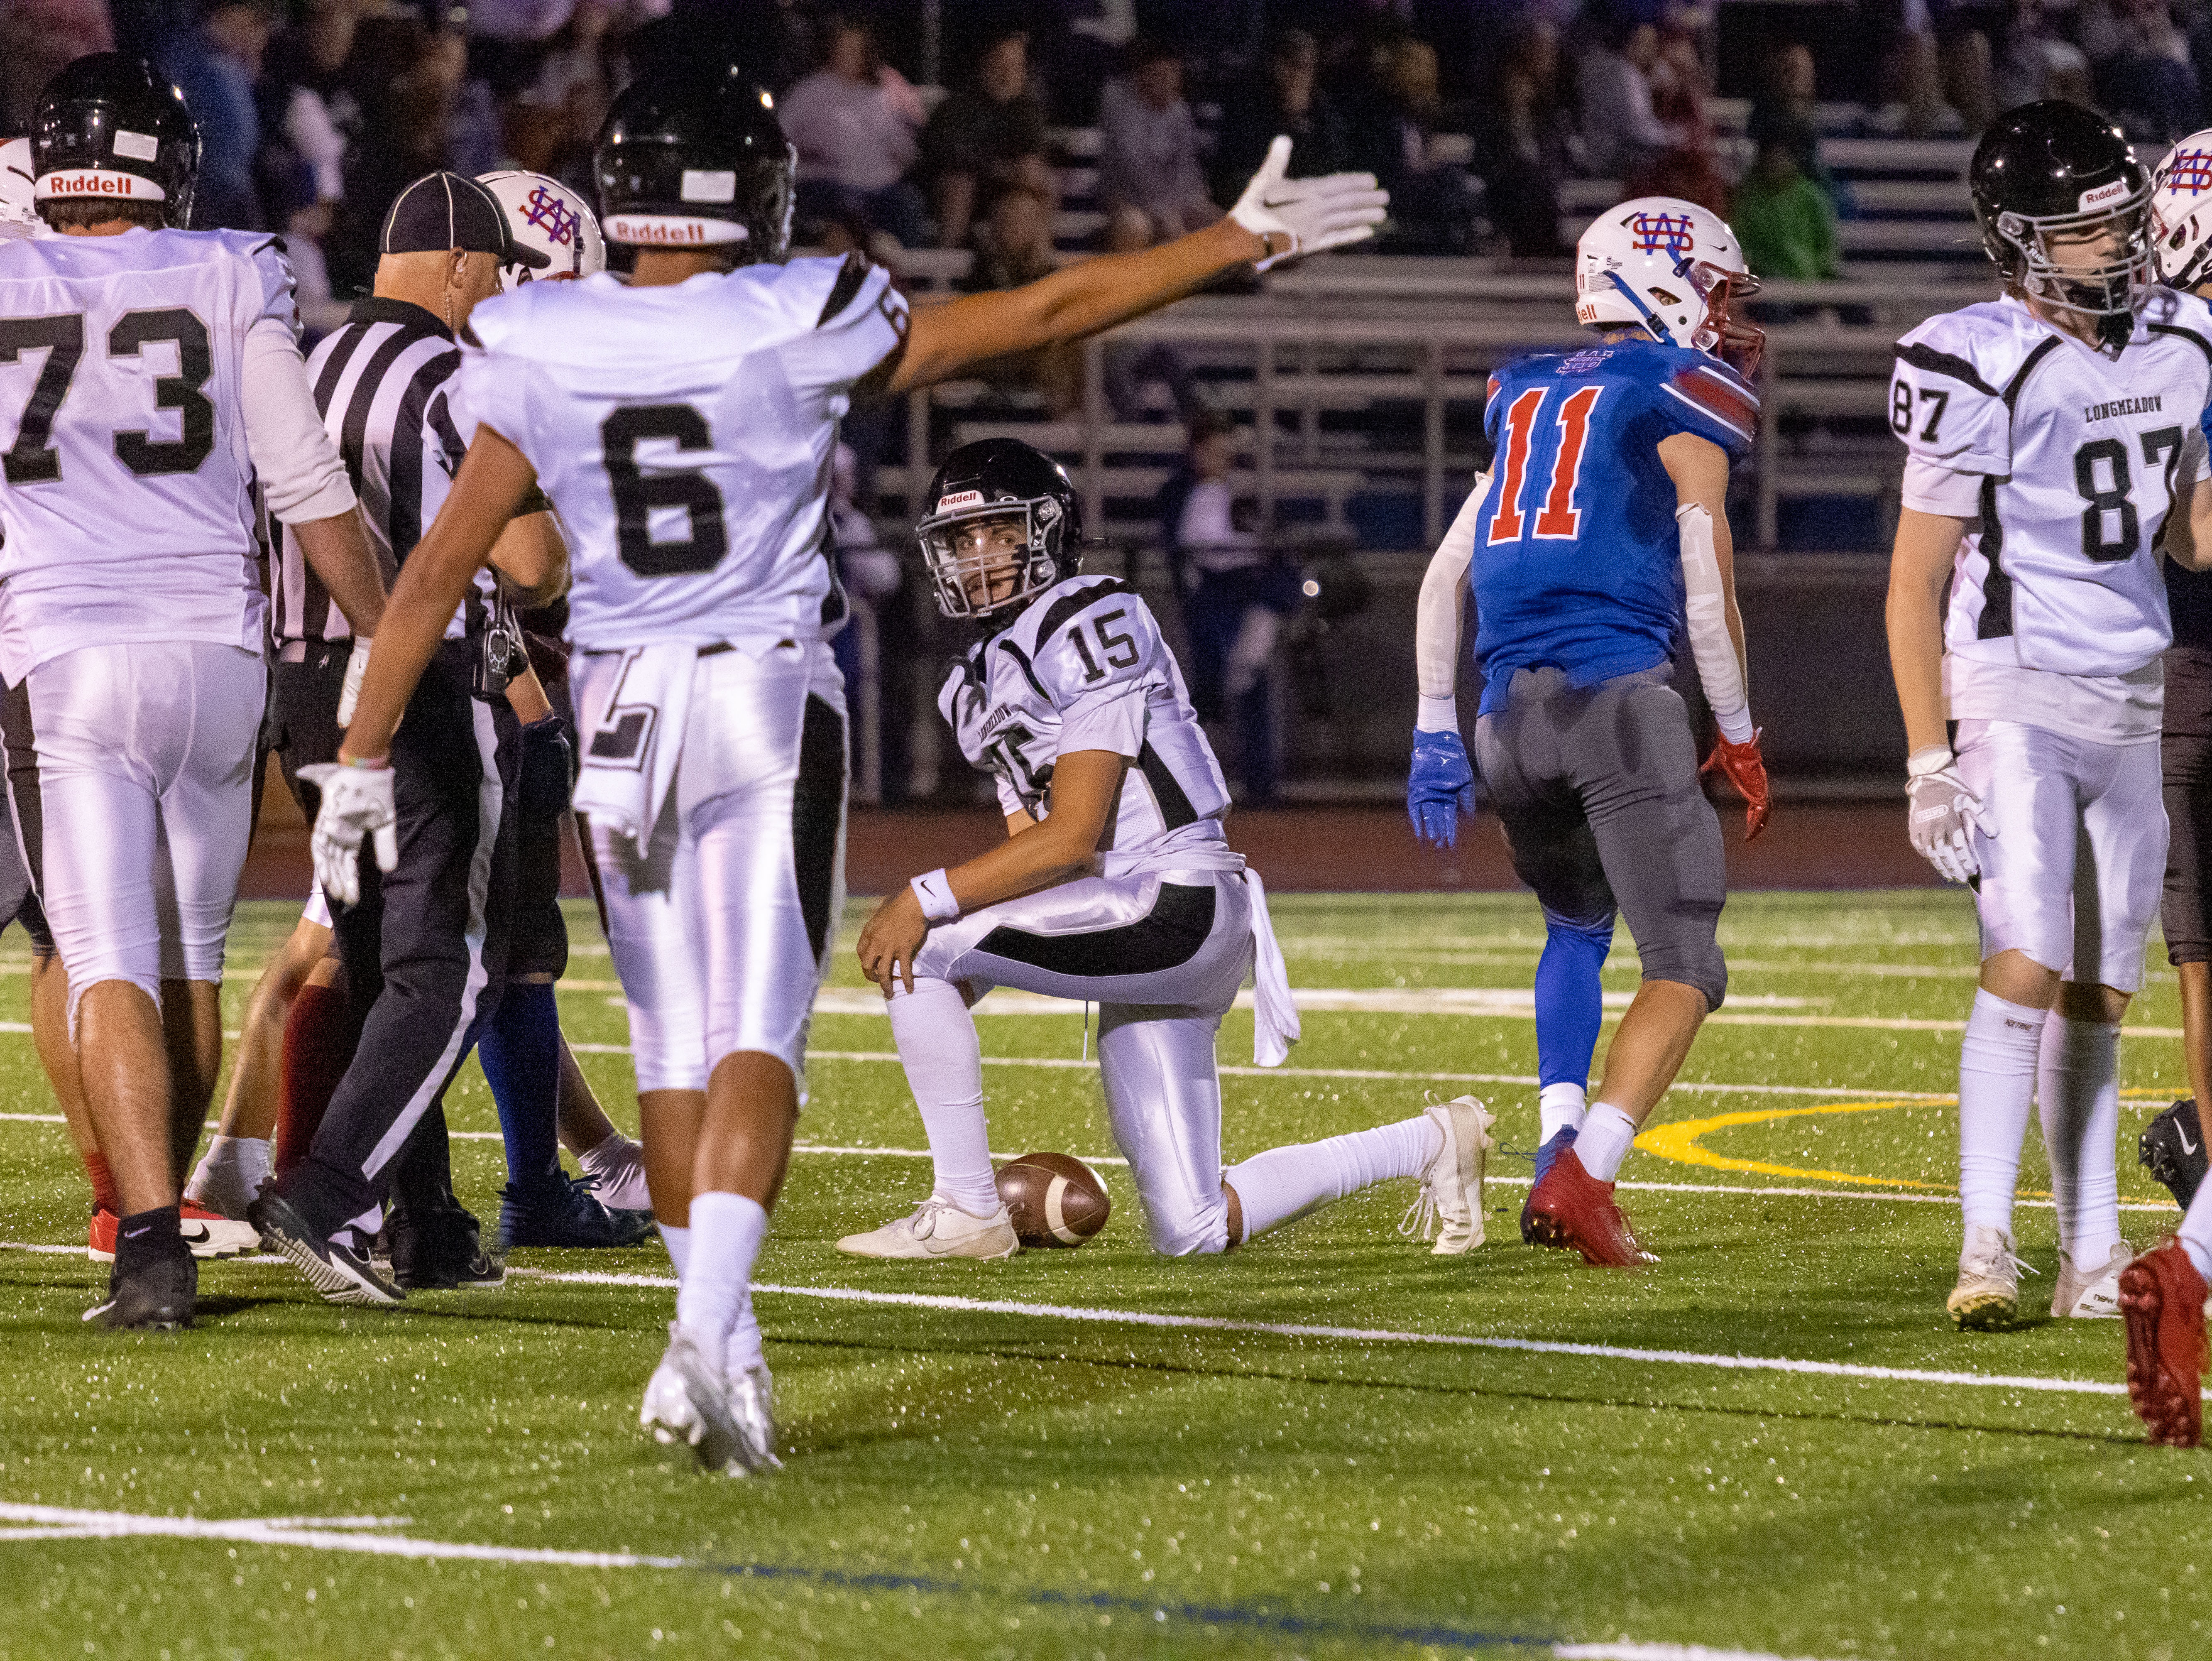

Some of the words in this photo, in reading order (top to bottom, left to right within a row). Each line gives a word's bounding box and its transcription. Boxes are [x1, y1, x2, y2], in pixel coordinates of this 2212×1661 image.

[51, 175, 131, 194] Riddell
[2086, 184, 2123, 203] Riddell
[617, 222, 705, 243] Riddell
[0, 305, 214, 478] 73
[1891, 378, 1950, 443] 87
[2085, 396, 2162, 423] LONGMEADOW
[1487, 385, 1605, 546] 11
[600, 401, 730, 577] 6
[941, 492, 976, 506] Riddell
[2073, 422, 2183, 566] 87
[1067, 608, 1140, 684] 15
[2094, 1294, 2115, 1304] new
